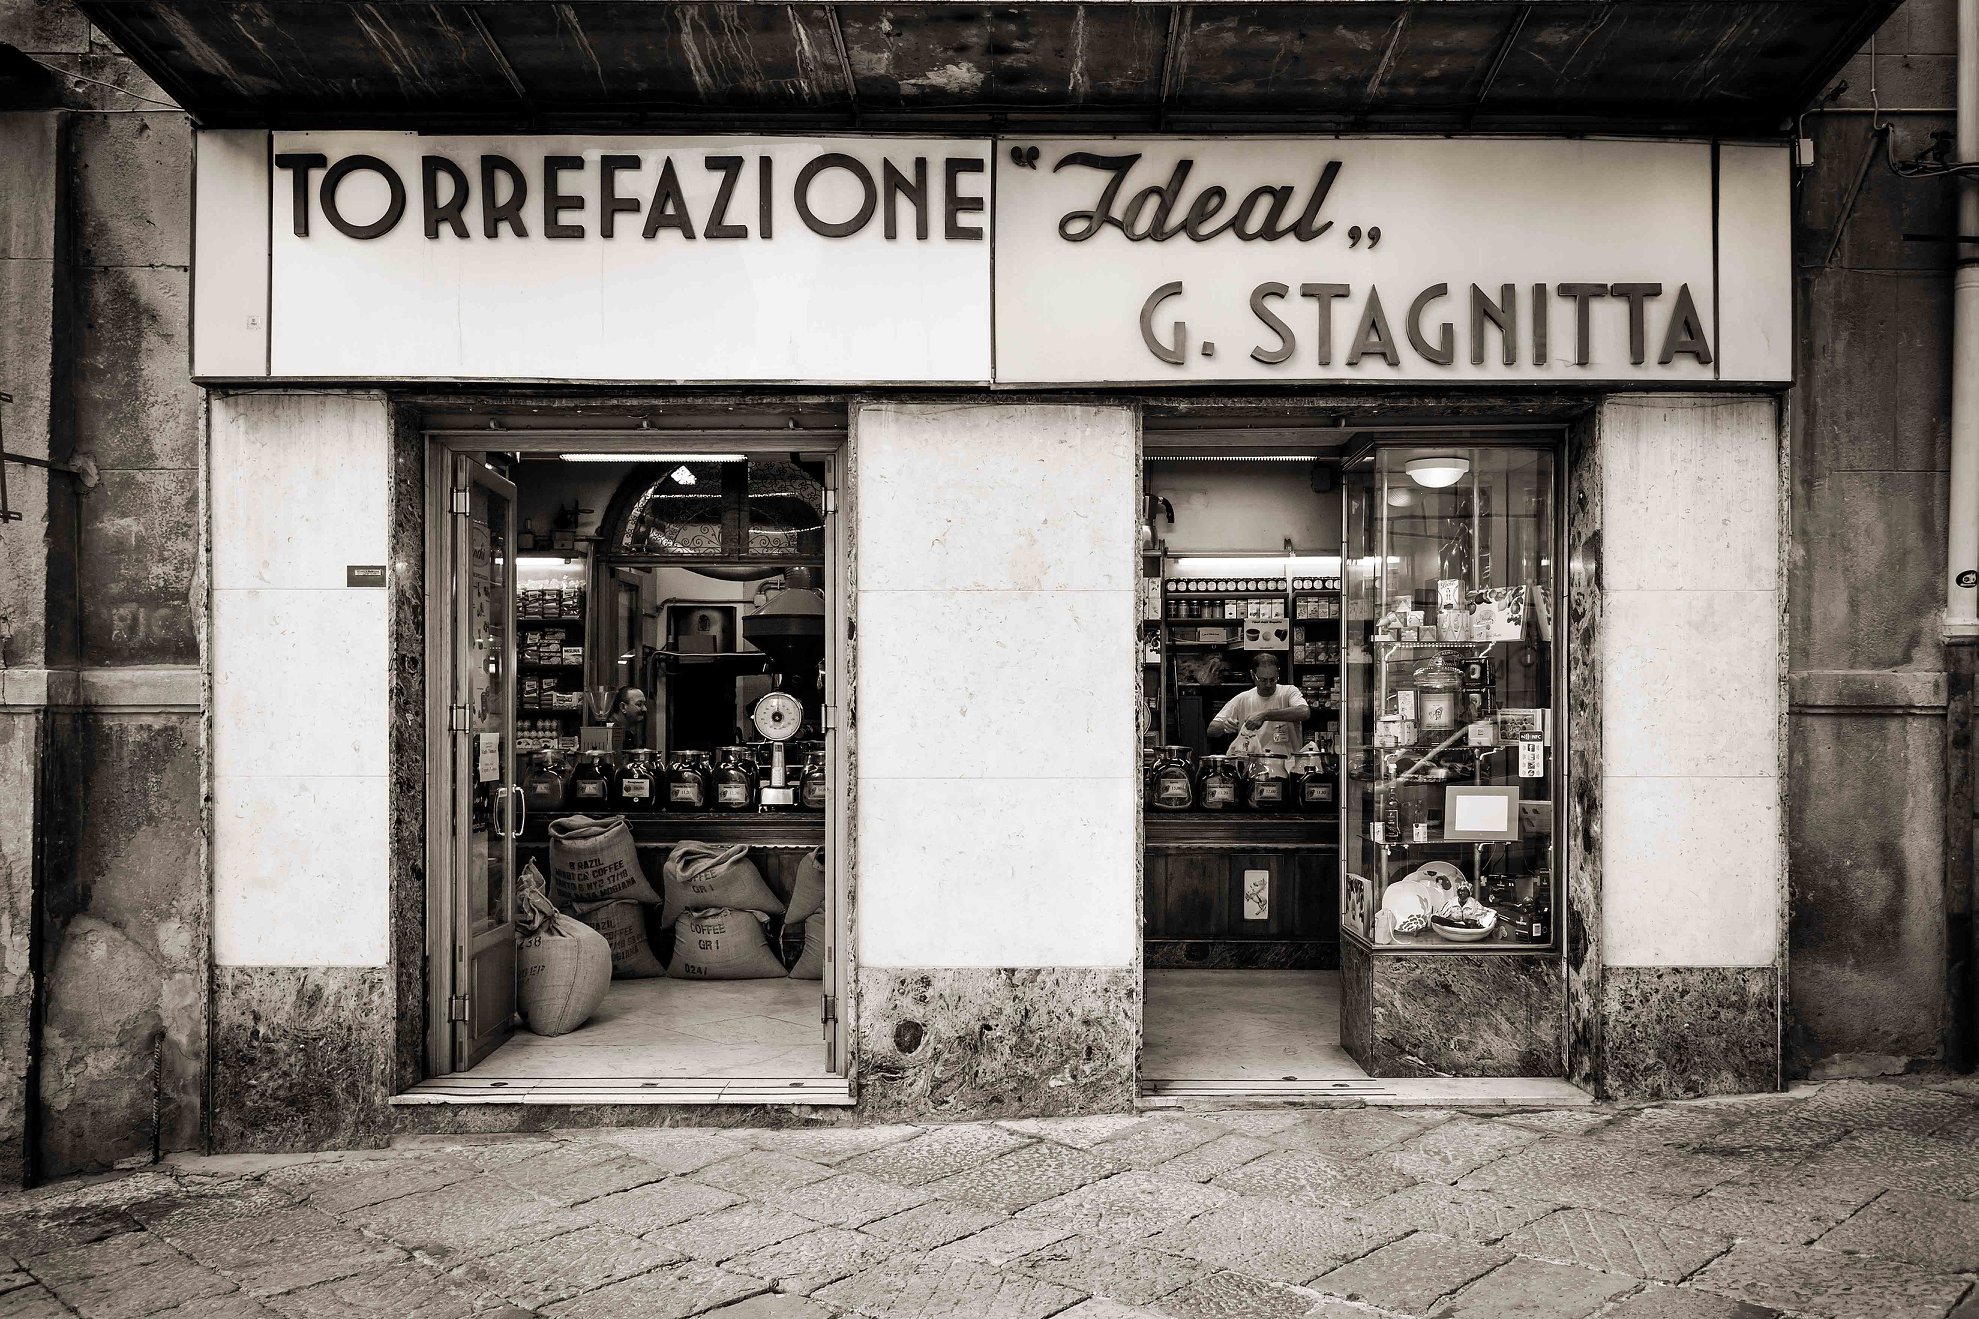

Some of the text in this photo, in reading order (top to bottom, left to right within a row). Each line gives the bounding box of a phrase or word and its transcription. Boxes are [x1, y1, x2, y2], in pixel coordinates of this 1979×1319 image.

[275, 153, 984, 240] TORREFAZIONE
[1140, 281, 1714, 367] G. STAGNITTA
[592, 860, 624, 878] COFFEE
[692, 885, 707, 894] GR
[588, 920, 616, 931] RAZIL
[690, 923, 726, 935] COFFEE
[698, 940, 712, 951] GR
